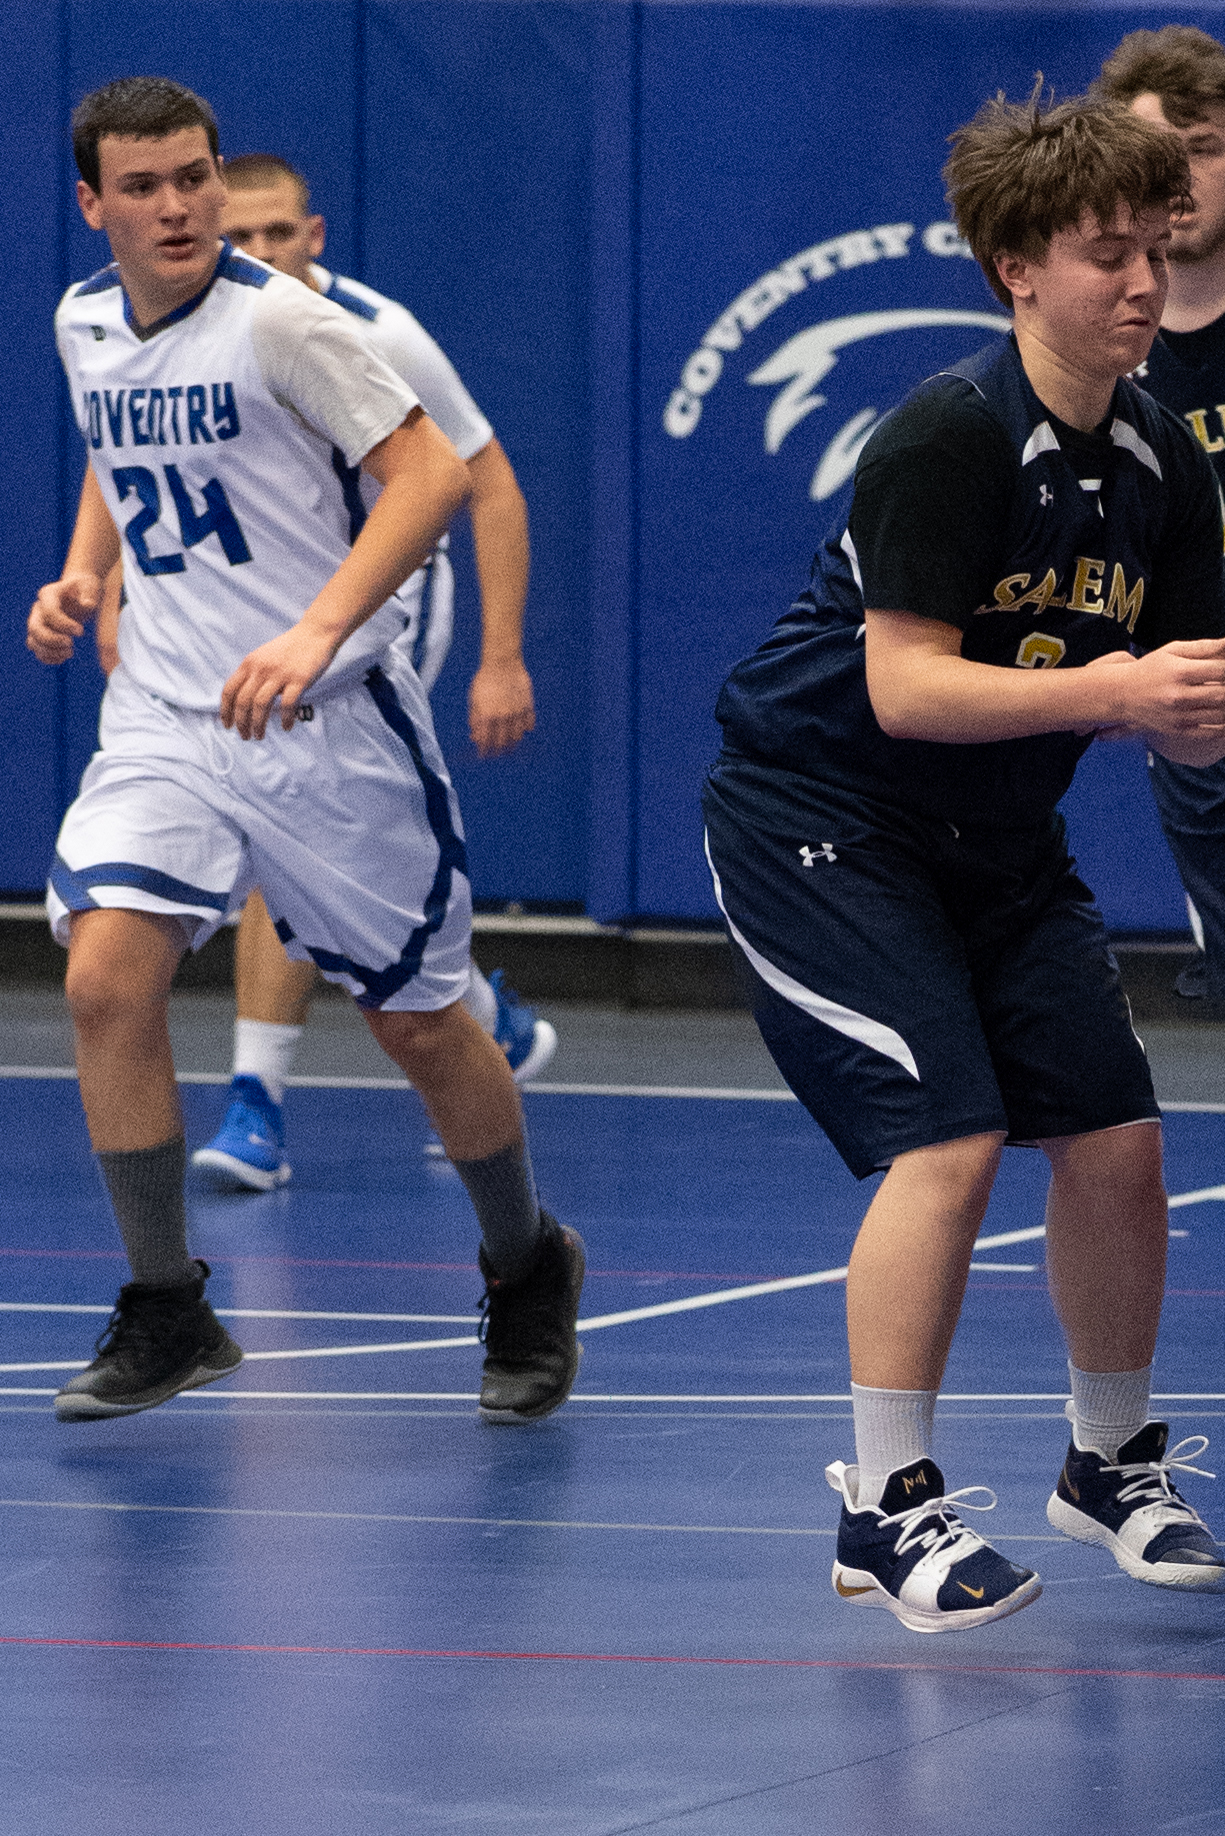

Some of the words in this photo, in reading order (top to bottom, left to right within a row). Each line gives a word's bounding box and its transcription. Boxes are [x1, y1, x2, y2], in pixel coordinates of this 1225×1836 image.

[662, 222, 915, 439] COVENTRY
[84, 381, 242, 450] OVENTRY
[112, 463, 253, 577] 24
[973, 556, 1145, 635] SALEM
